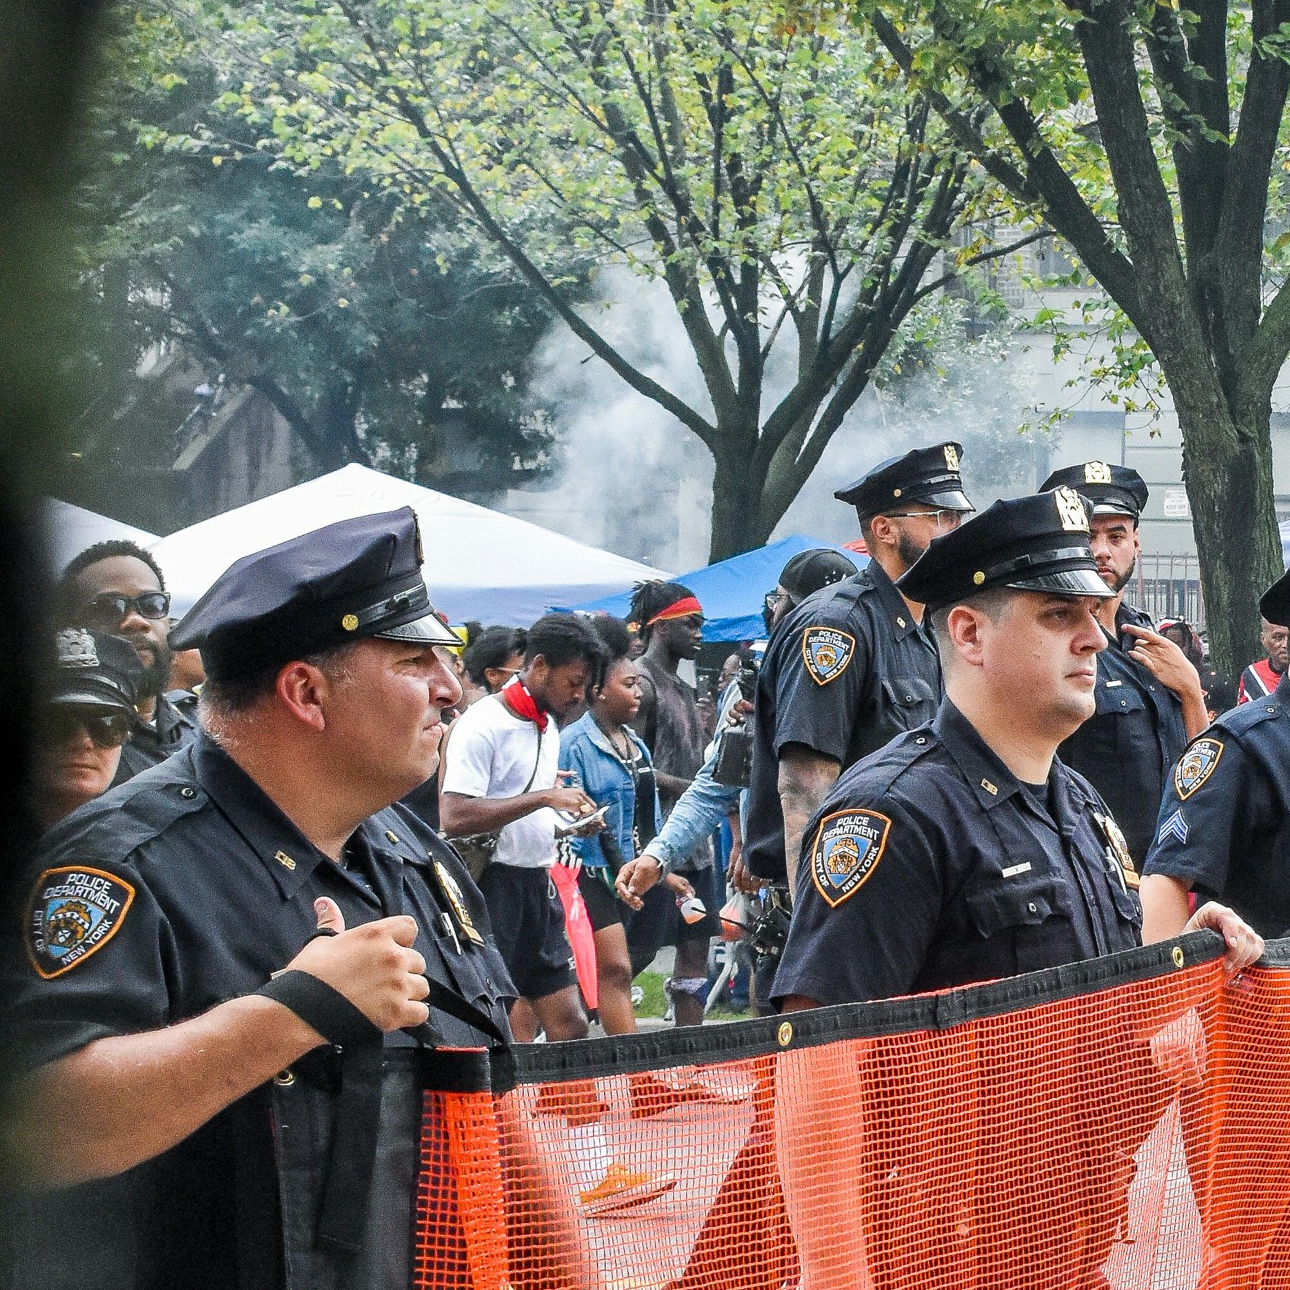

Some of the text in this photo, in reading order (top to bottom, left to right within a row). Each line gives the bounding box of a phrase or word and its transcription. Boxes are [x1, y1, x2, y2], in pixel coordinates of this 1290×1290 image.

[819, 631, 842, 640] POLICE
[822, 825, 879, 841] DEPARTMENT
[836, 816, 869, 827] POLICE
[816, 852, 830, 887] CITY OF
[841, 846, 879, 893] NEW YORK
[66, 873, 112, 895] POLICE
[43, 885, 120, 914] DEPARTMENT
[61, 919, 113, 965] NEW YORK
